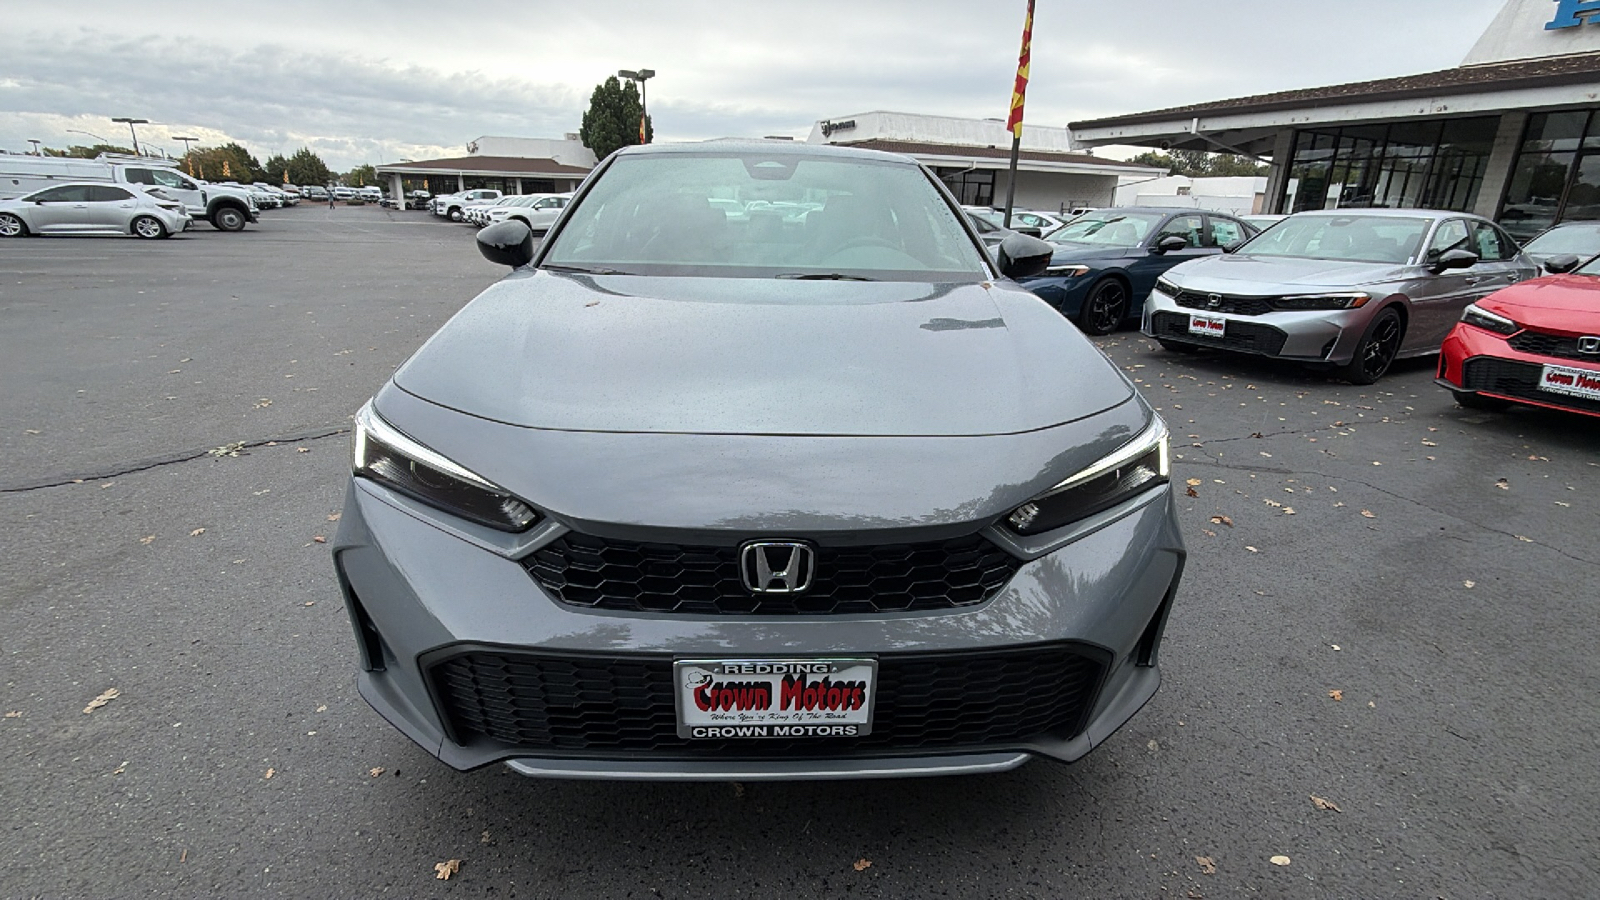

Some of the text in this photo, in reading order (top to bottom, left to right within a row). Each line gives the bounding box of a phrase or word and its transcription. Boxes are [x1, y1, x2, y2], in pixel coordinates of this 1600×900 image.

[1546, 372, 1574, 386] Crown
[724, 664, 829, 674] REDDING
[693, 674, 866, 712] Crown Motors
[710, 712, 736, 721] Where
[738, 713, 766, 723] You're
[768, 713, 789, 722] King
[792, 713, 804, 721] Of
[692, 725, 858, 738] CROWN MOTORS
